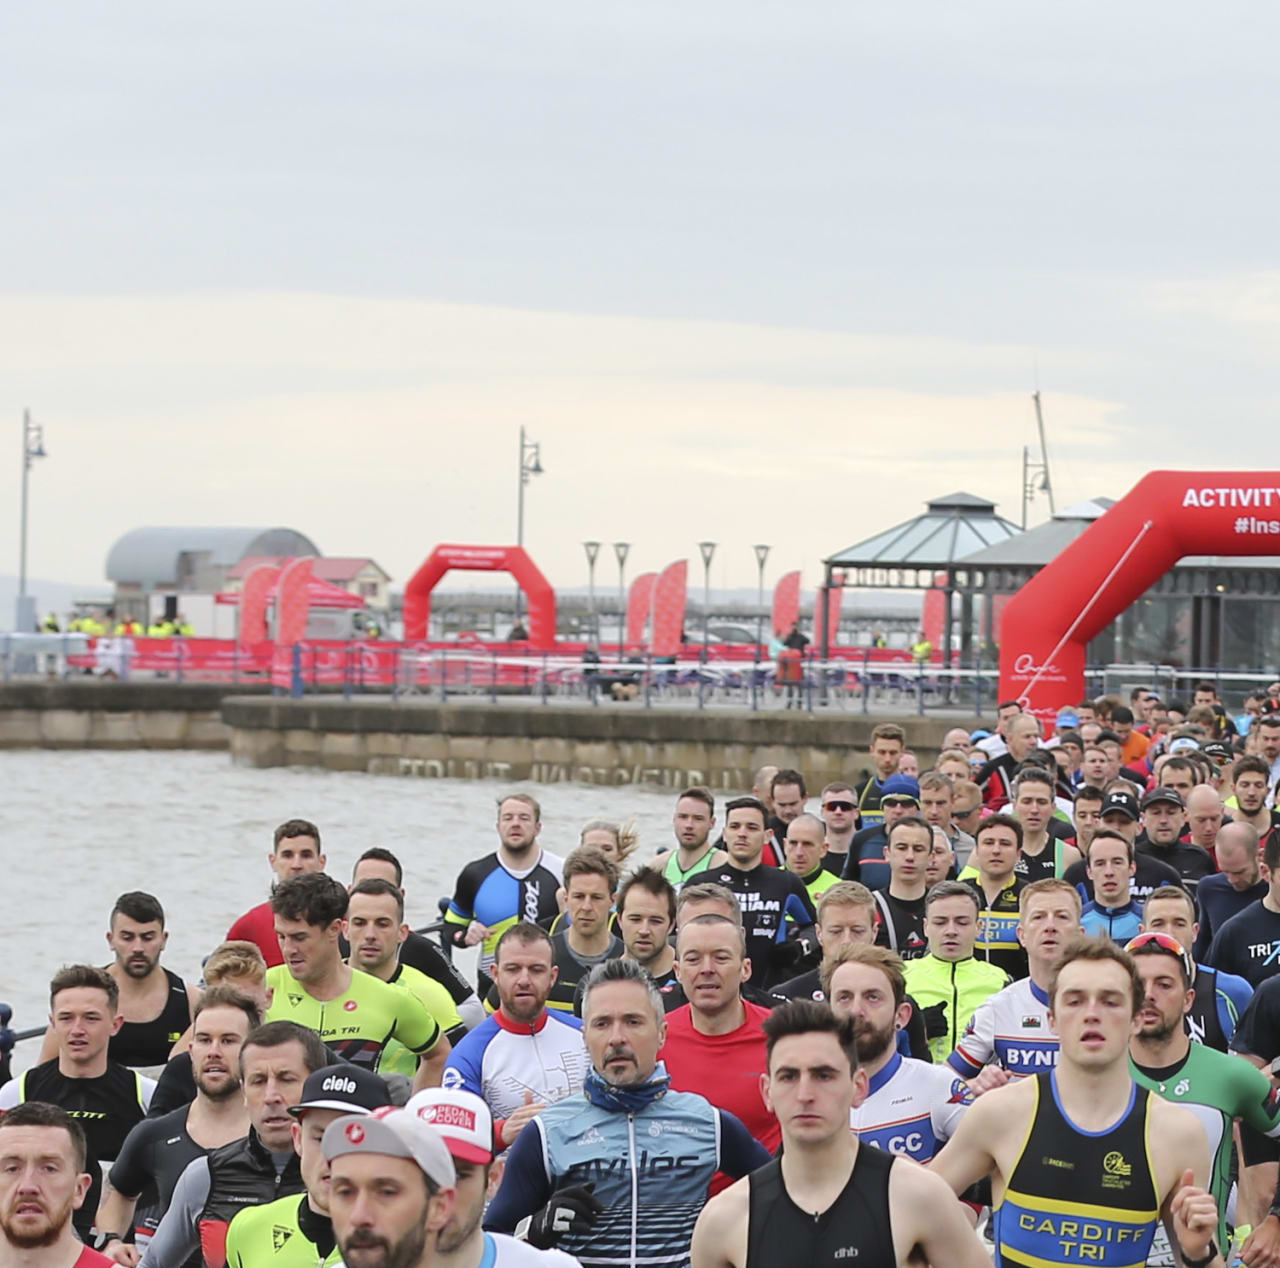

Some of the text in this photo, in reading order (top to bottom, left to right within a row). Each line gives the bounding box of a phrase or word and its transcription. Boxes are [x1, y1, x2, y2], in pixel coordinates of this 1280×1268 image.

[342, 1026, 360, 1035] TRI
[322, 1075, 357, 1093] ciele
[437, 1104, 470, 1119] PEDAL
[436, 1114, 472, 1128] COVER
[1019, 1212, 1146, 1244] CARDIFF
[834, 1246, 858, 1259] dhb
[1058, 1239, 1106, 1261] TRI
